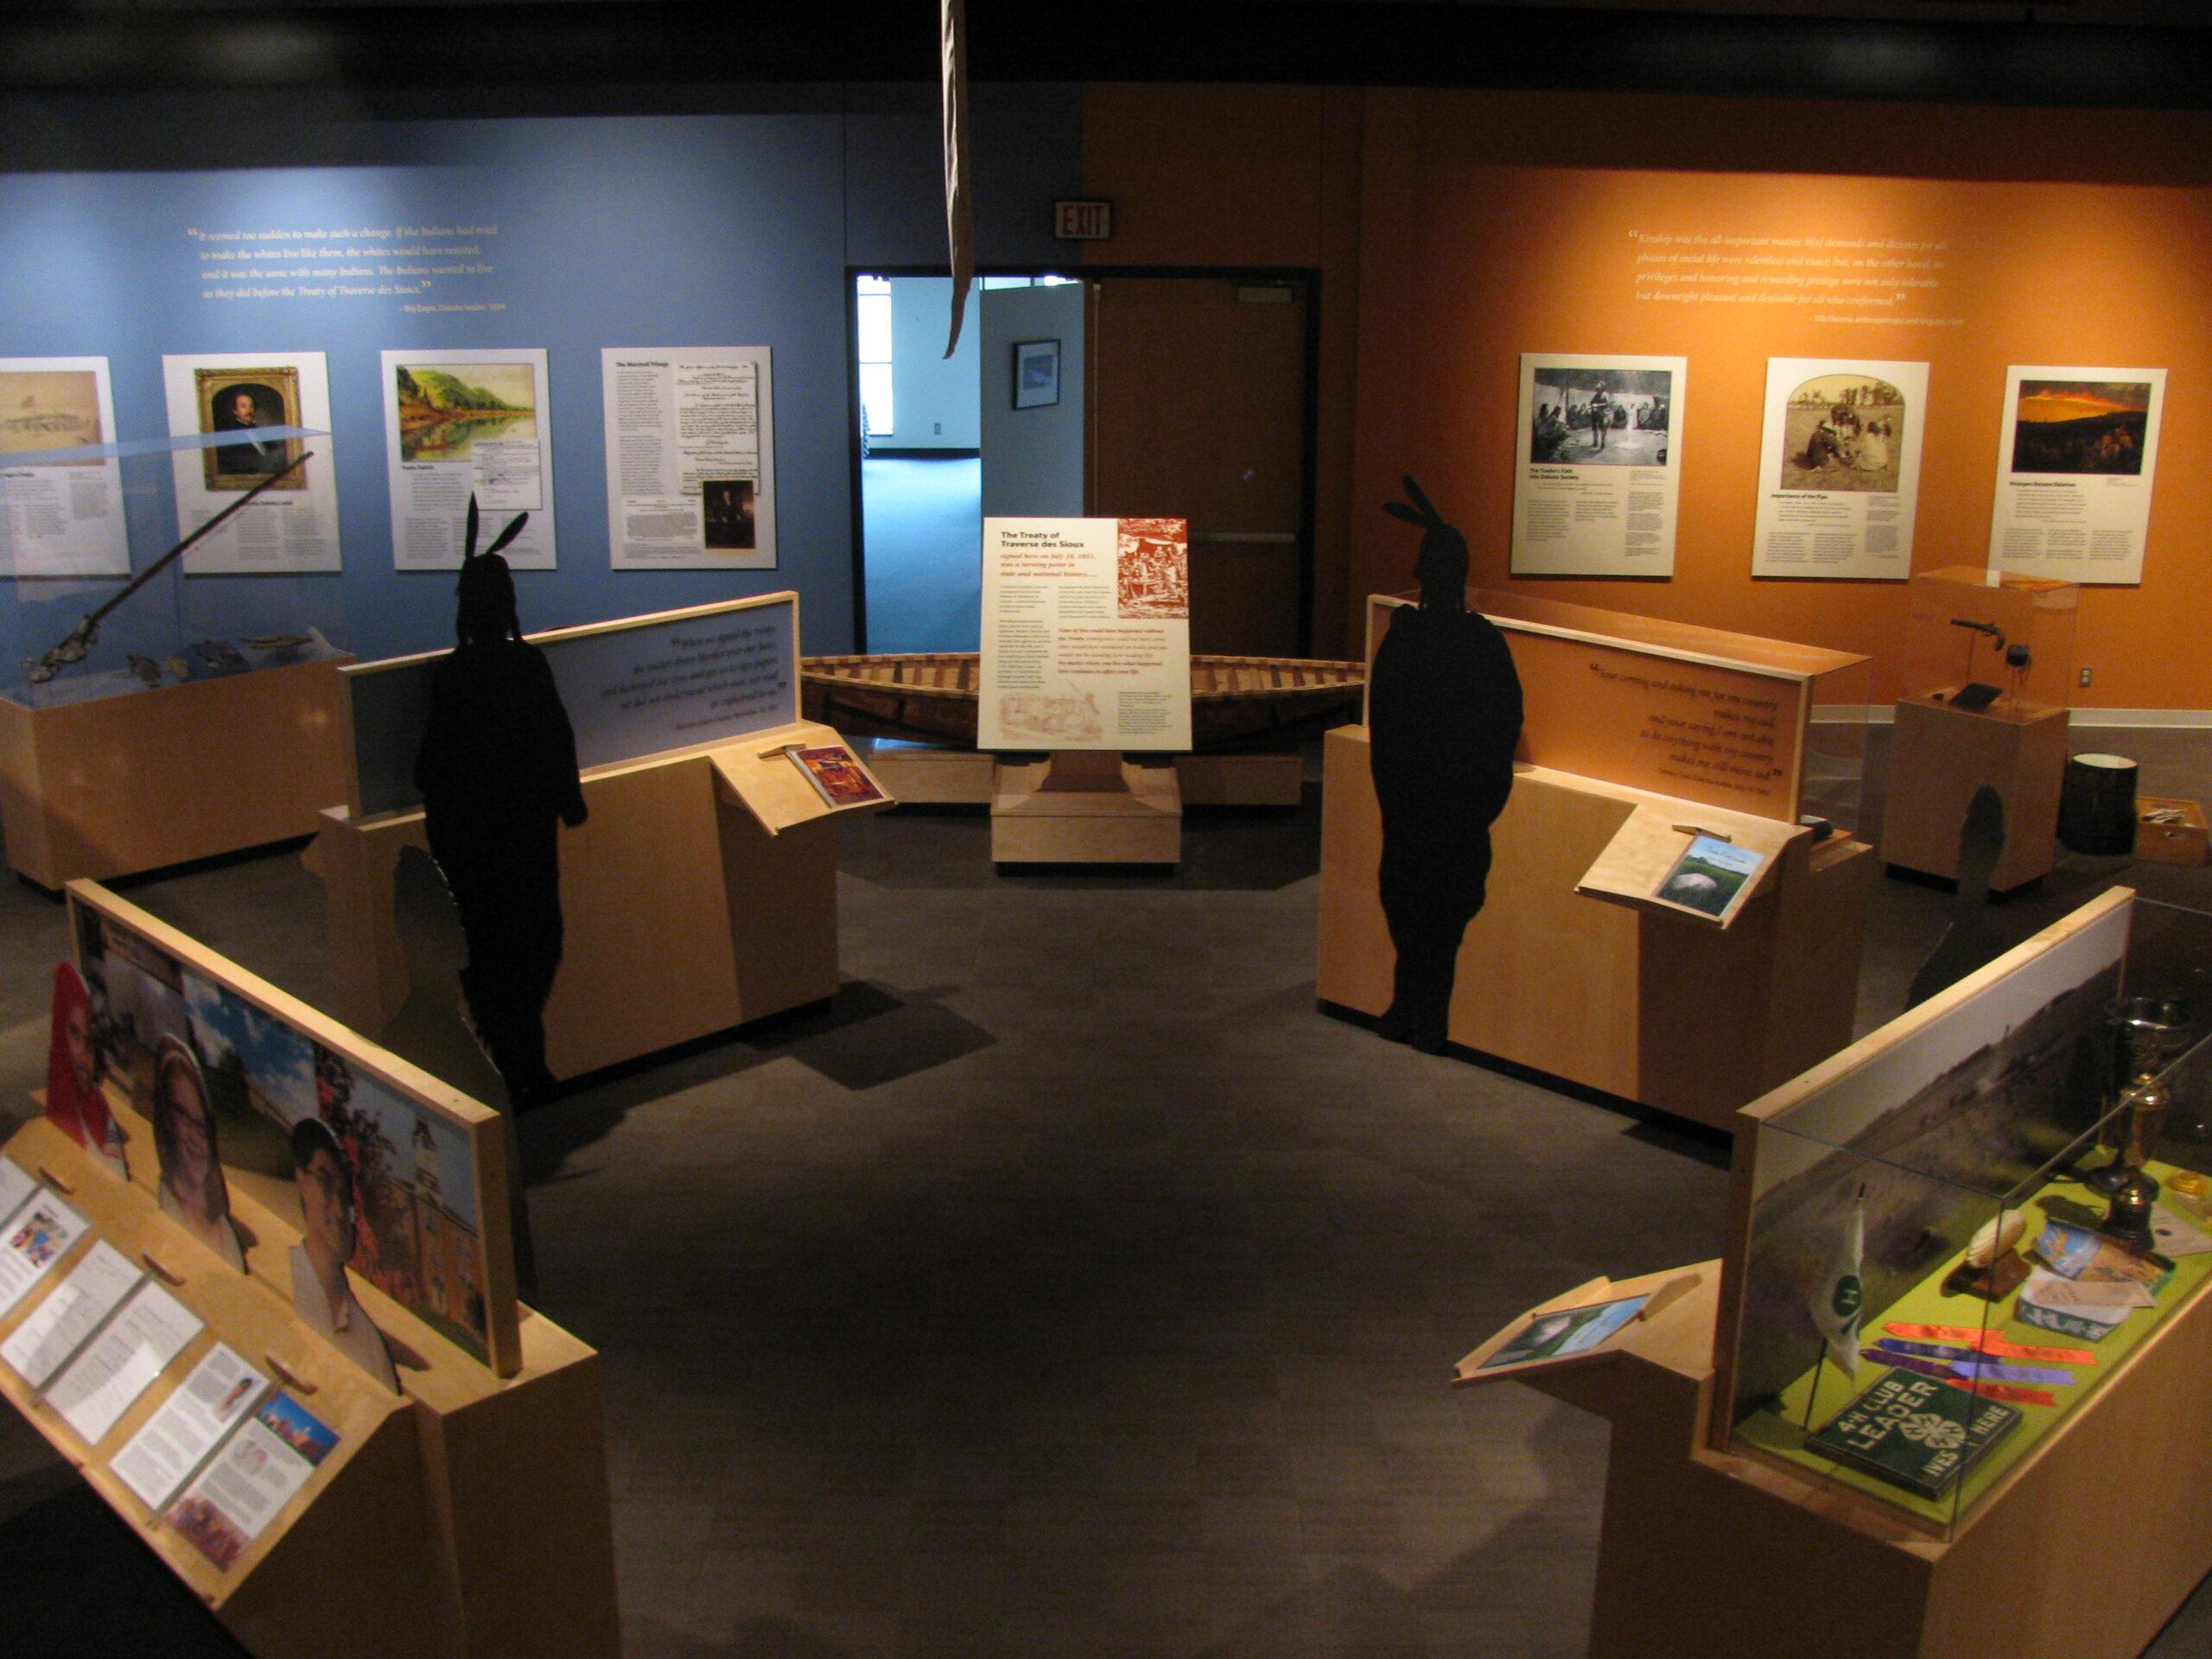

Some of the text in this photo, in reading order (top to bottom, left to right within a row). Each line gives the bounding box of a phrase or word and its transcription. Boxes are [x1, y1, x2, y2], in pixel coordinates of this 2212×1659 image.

[1063, 205, 1104, 236] EXIT
[1020, 531, 1048, 541] Treaty
[1837, 1380, 1905, 1433] 4-H CLUB
[1847, 1380, 1940, 1450] LEADER
[1968, 1404, 2011, 1436] HERE
